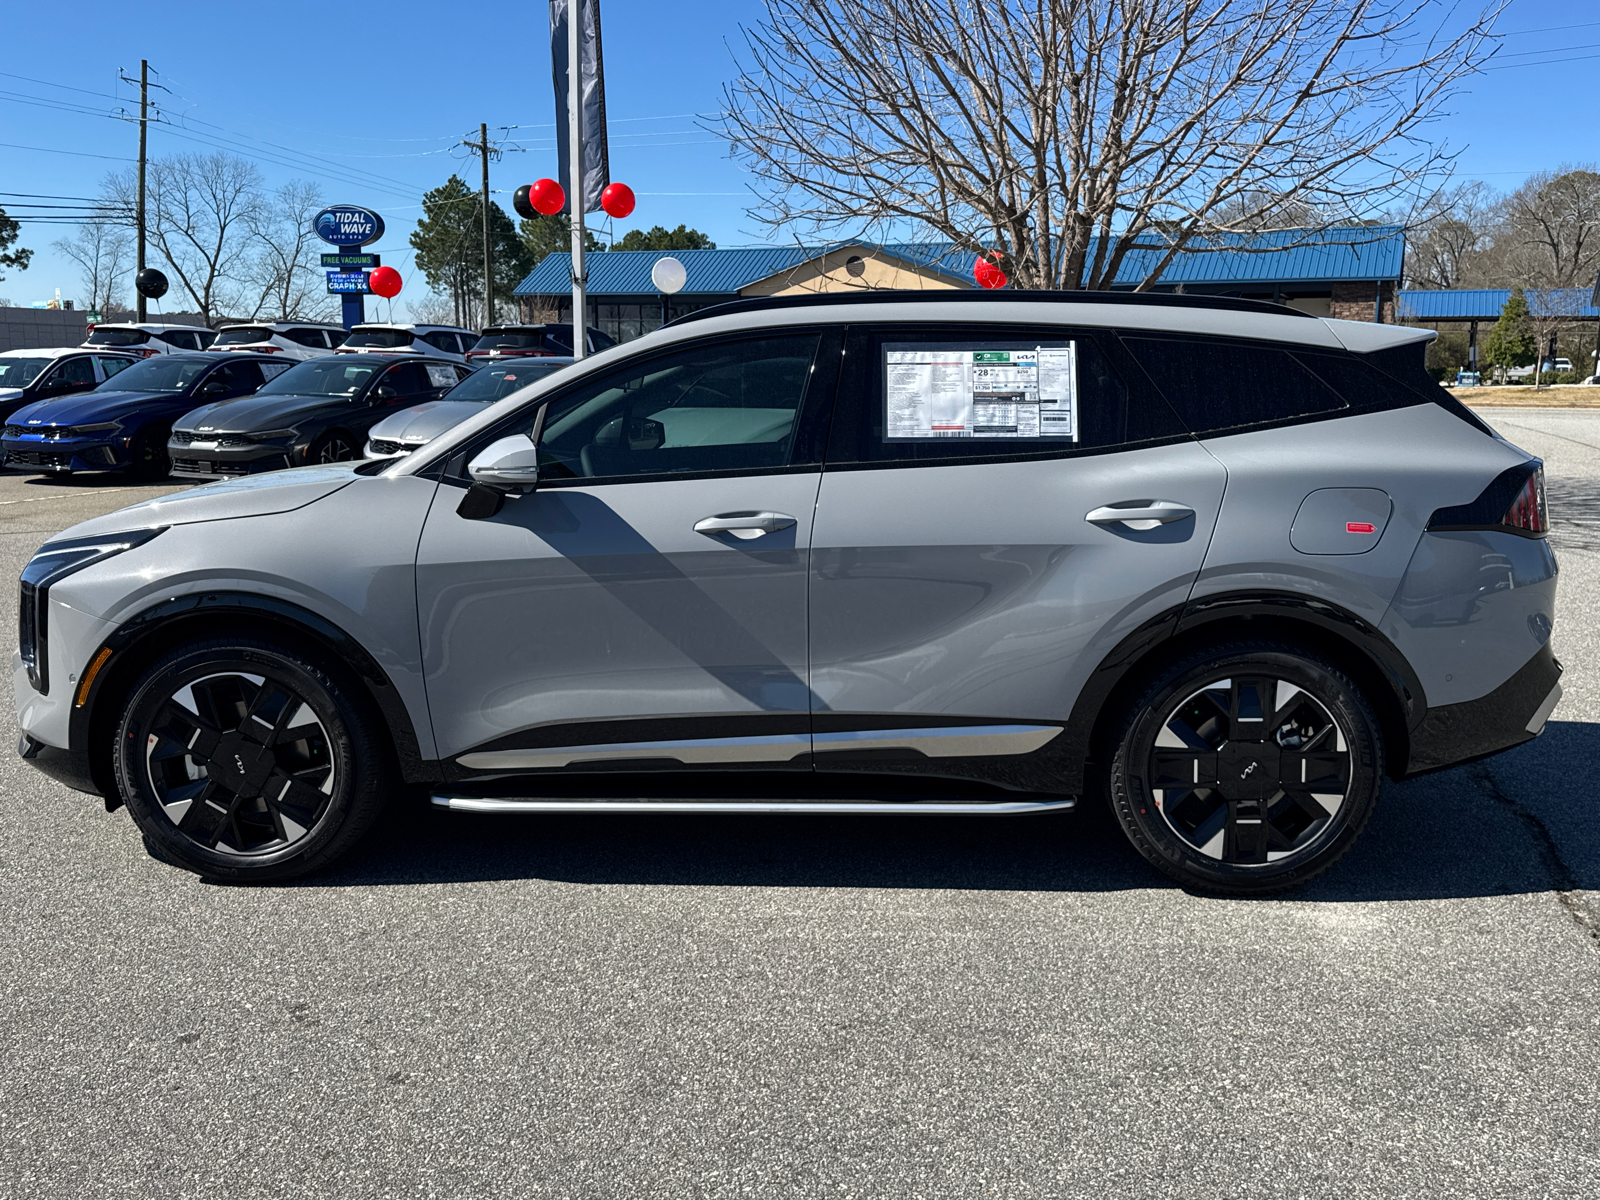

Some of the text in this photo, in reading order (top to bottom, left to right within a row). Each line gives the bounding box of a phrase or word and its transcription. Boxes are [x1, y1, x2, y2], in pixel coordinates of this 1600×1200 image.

[335, 213, 365, 223] TIDAL
[340, 223, 372, 234] WAVE
[323, 256, 371, 264] FREE VACUUMS
[977, 368, 989, 377] 28
